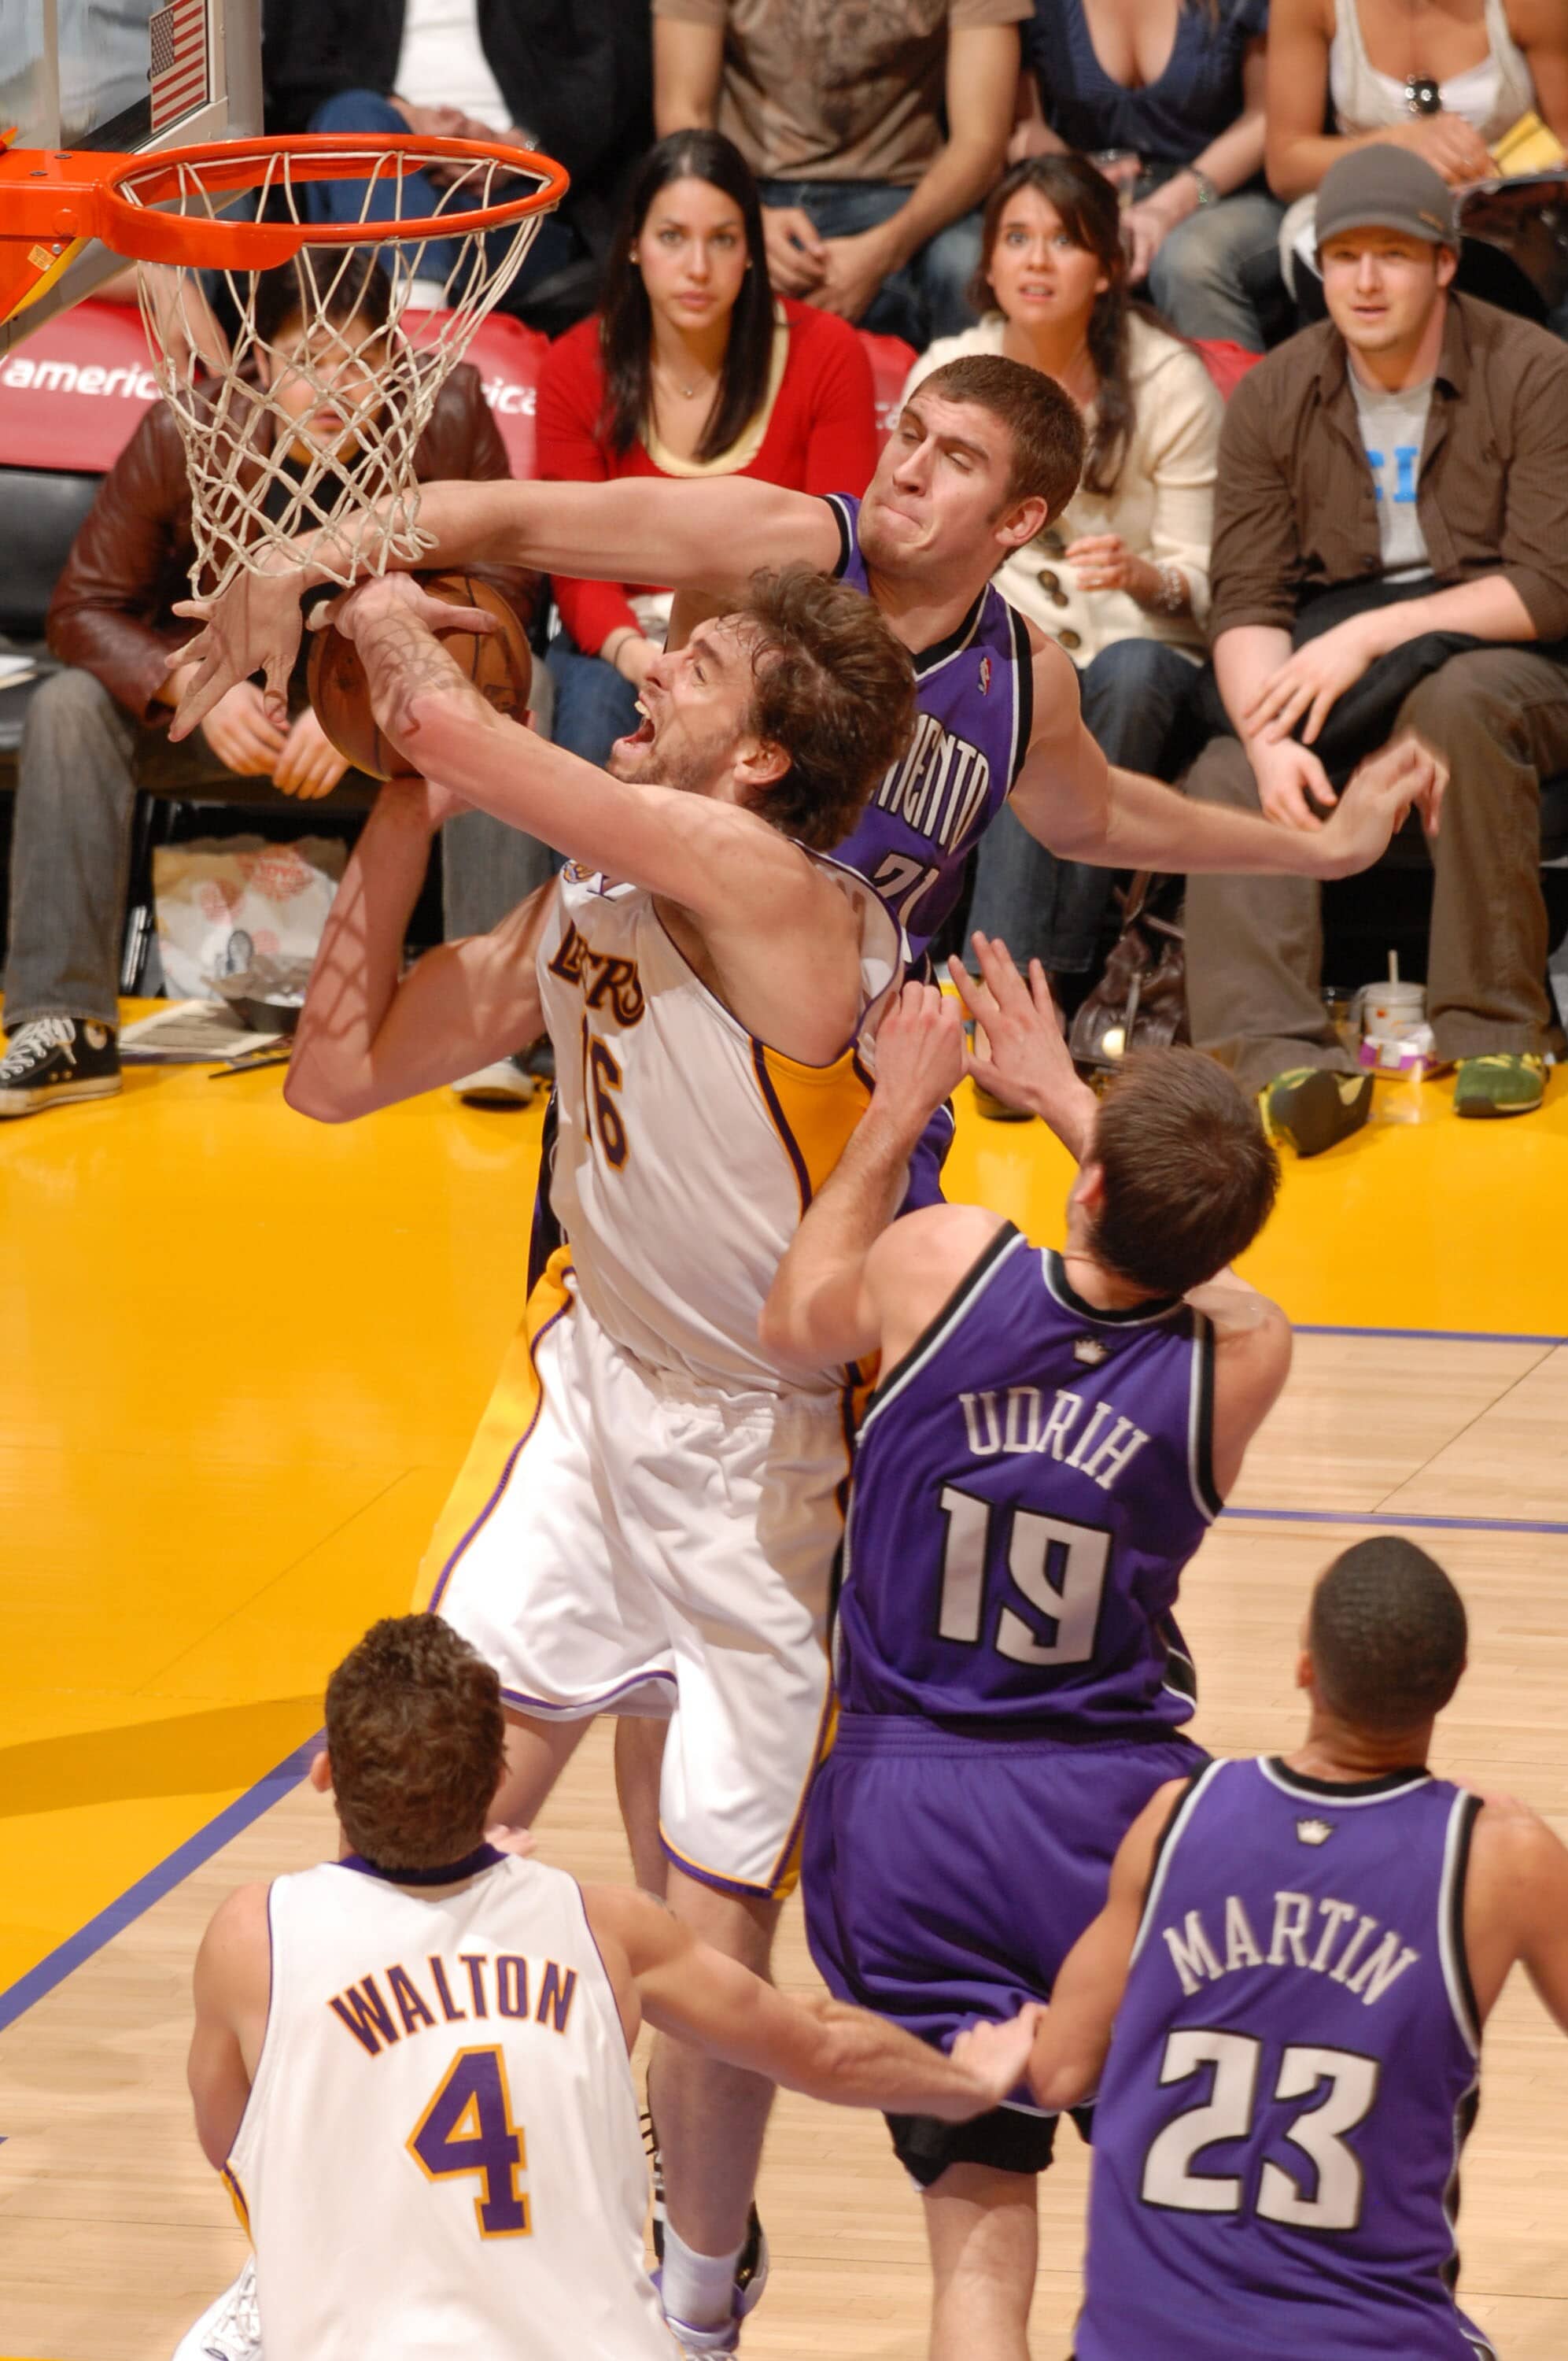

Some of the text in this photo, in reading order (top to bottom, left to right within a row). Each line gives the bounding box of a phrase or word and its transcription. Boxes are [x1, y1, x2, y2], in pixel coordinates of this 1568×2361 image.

[579, 1009, 629, 1173] 16
[957, 1386, 1150, 1490] UDRIH
[935, 1482, 1112, 1666] 19
[327, 1953, 578, 2058] WALTON
[1162, 1891, 1419, 2005] MARTIN
[404, 2043, 533, 2241] 4
[1141, 2028, 1380, 2230] 23
